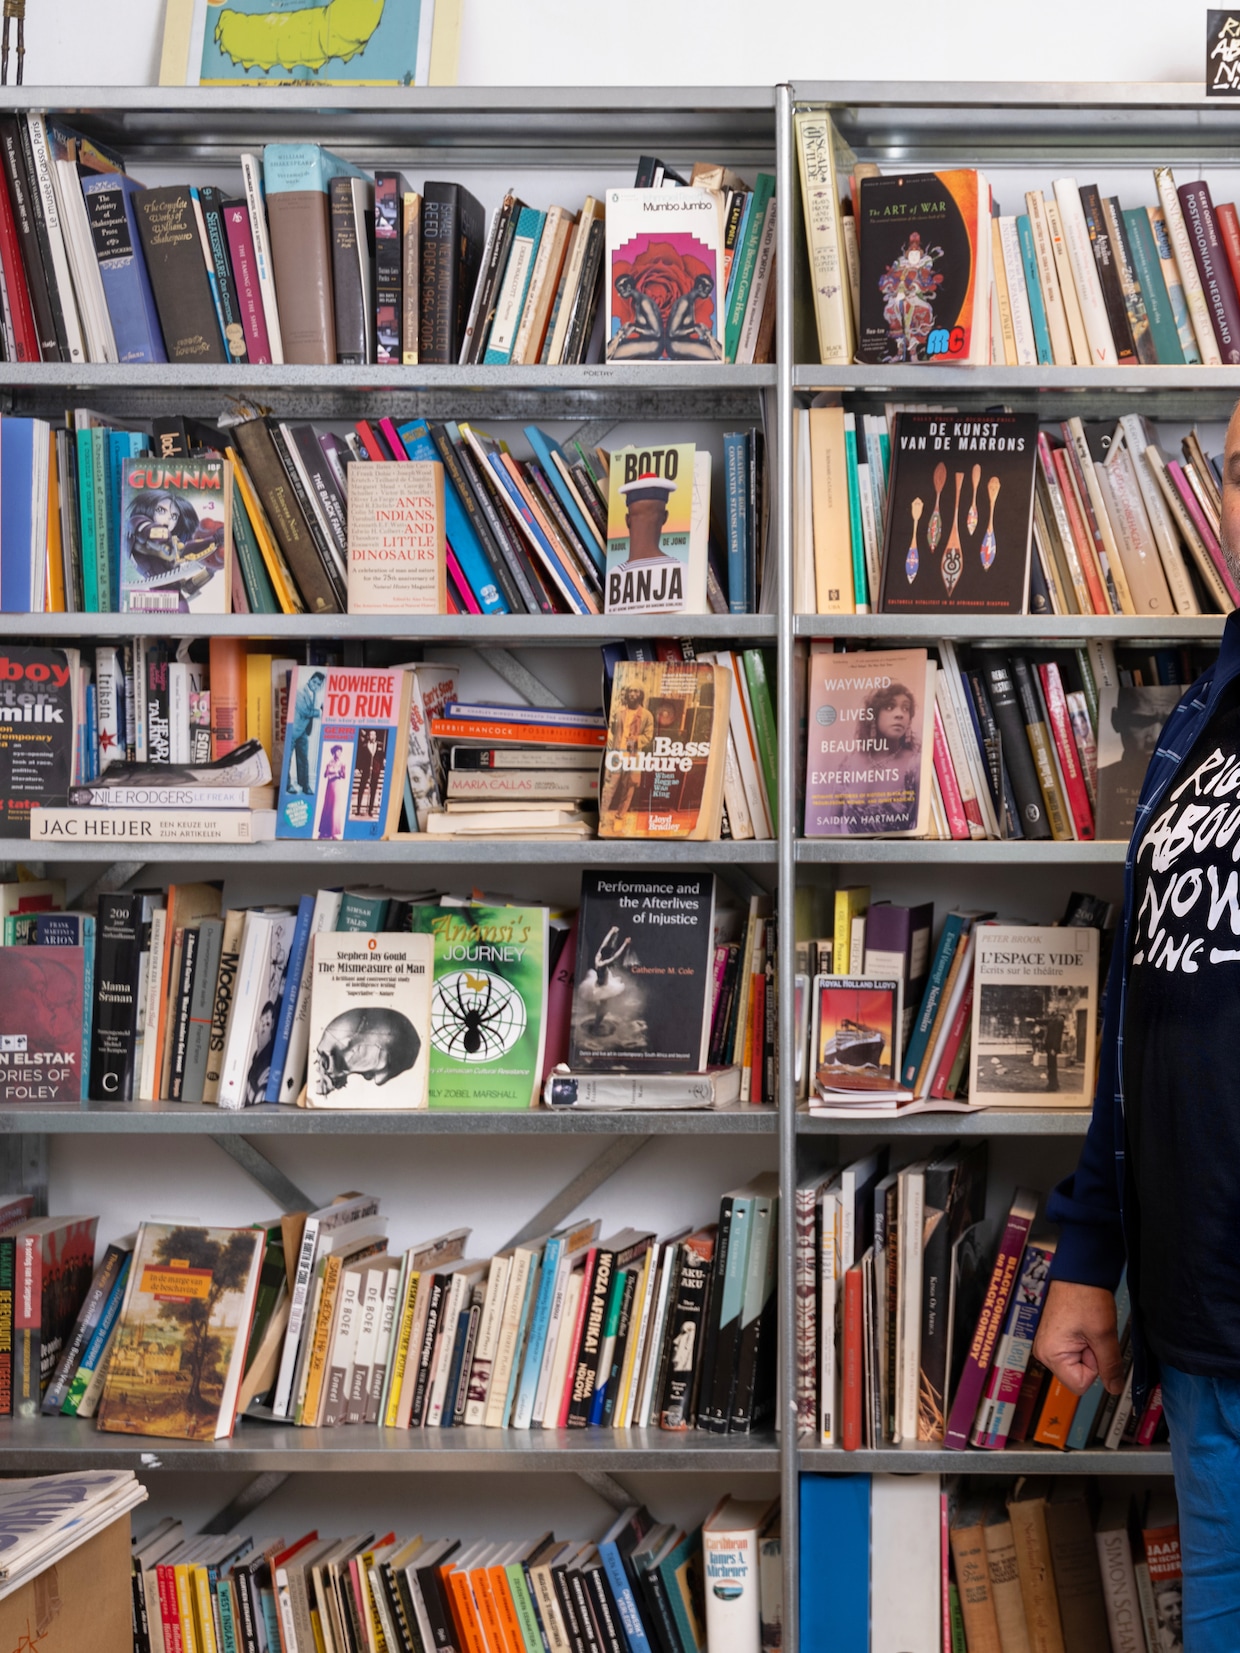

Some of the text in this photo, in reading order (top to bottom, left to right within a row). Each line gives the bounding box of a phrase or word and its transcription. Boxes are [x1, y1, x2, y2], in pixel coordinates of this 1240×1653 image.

[33, 121, 57, 228] Le musée Picasso, Paris
[643, 202, 712, 211] Mumbo Jumbo
[869, 201, 947, 217] The ART of WAR
[1199, 191, 1218, 247] GERT OOSTINDIE
[240, 260, 251, 289] TAMING
[1186, 193, 1231, 345] POSTKOLONIAAL NEDERLAND
[245, 289, 253, 298] OF
[247, 299, 255, 312] THE
[250, 313, 259, 338] SHREW
[930, 423, 999, 436] DE KUNST
[900, 437, 1025, 452] VAN DE MARRONS
[624, 449, 678, 484] BOTO
[128, 470, 220, 490] GUNNM
[395, 497, 435, 509] ANTS,
[376, 510, 435, 521] INDIANS,
[402, 523, 435, 534] AND
[382, 536, 435, 547] LITTLE
[610, 536, 687, 551] RAOUL DE JONG
[351, 549, 435, 561] DINOSAURS
[609, 567, 683, 605] BANJA
[0, 658, 70, 686] boy
[327, 675, 395, 693] NOWHERE
[824, 677, 891, 692] WAYWARD
[327, 695, 392, 718] TO RUN
[0, 704, 63, 723] milk
[840, 707, 874, 721] LIVES
[435, 723, 513, 735] HERBIE HANCOCK
[654, 737, 710, 757] Bass
[821, 739, 889, 753] BEAUTIFUL
[605, 750, 692, 772] Culture
[811, 768, 899, 784] EXPERIMENTS
[452, 779, 532, 791] MARIA CALLAS
[94, 791, 122, 804] NILE
[126, 790, 193, 804] RODGERS
[207, 793, 236, 801] FREAK
[648, 815, 671, 824] Lloyd
[817, 813, 909, 826] SAIDIYA HARTMAN
[40, 821, 77, 835] JAC
[84, 820, 152, 836] HEIJER
[180, 829, 221, 837] ARTIKELEN
[648, 822, 680, 831] Bradley
[597, 881, 700, 895] Performance and
[619, 897, 699, 910] the Afterlives
[110, 909, 129, 919] 200
[633, 912, 698, 925] of Injustice
[431, 915, 531, 943] Anansi's
[44, 936, 75, 945] ARION
[981, 935, 1042, 944] PETER BROOK
[337, 952, 407, 962] Stephen Jay Gould
[443, 946, 526, 962] JOURNEY
[1148, 928, 1204, 973] INC
[981, 953, 1083, 966] L'ESPACE VIDE
[318, 963, 425, 974] The Mismeasure of Man
[101, 981, 131, 993] Mama
[819, 980, 896, 989] ROYAL HOLLAND LLOYD
[99, 993, 133, 1004] Sranan
[14, 1053, 75, 1065] ELSTAK
[48, 1069, 70, 1081] OF
[5, 1086, 60, 1099] FOLEY
[442, 1090, 517, 1099] ZOBEL MARSHALL
[681, 1267, 706, 1279] AKU-
[681, 1279, 704, 1289] AKU
[585, 1253, 613, 1354] WOZA AFRIKA!
[969, 1266, 1003, 1362] BLACK COMEDY
[978, 1256, 1017, 1370] BLACK COMEDIANS
[705, 1538, 748, 1550] Caribbean
[709, 1553, 746, 1564] James A.
[706, 1565, 748, 1578] Michener
[1105, 1537, 1129, 1595] SIMON
